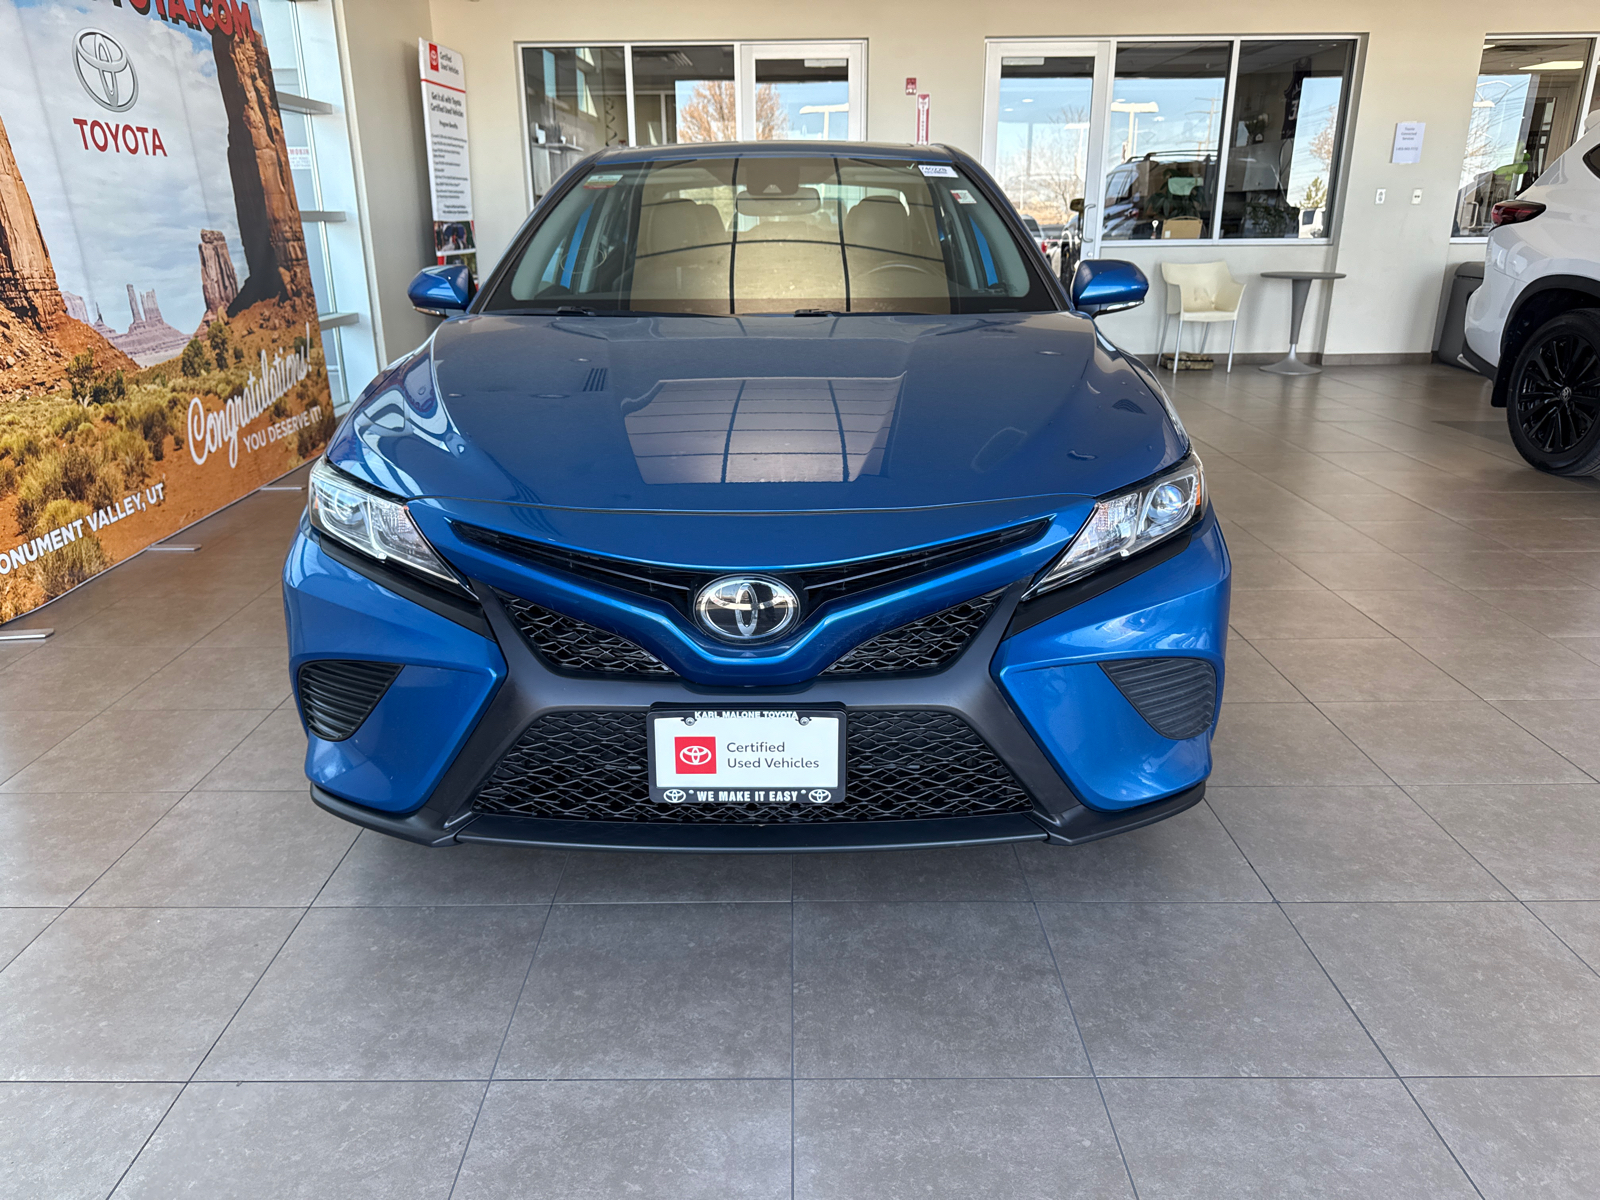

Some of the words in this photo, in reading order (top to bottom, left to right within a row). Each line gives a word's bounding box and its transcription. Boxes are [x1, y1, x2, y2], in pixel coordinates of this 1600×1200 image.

[73, 118, 168, 157] TOYOTA
[187, 321, 312, 469] Congratulations!
[243, 429, 267, 453] YOU
[267, 414, 310, 443] DESERVE
[310, 405, 323, 425] IT!
[85, 492, 147, 533] VALLEY,
[145, 482, 165, 505] UT
[694, 711, 719, 719] KARL
[721, 711, 761, 719] MALONE
[762, 711, 798, 719] TOYOTA
[726, 741, 786, 754] Certified
[727, 757, 761, 769] Used
[764, 757, 820, 769] Vehicles
[697, 790, 714, 802] WE
[718, 790, 750, 802] MAKE
[754, 790, 766, 802] IT
[769, 790, 798, 802] EASY
